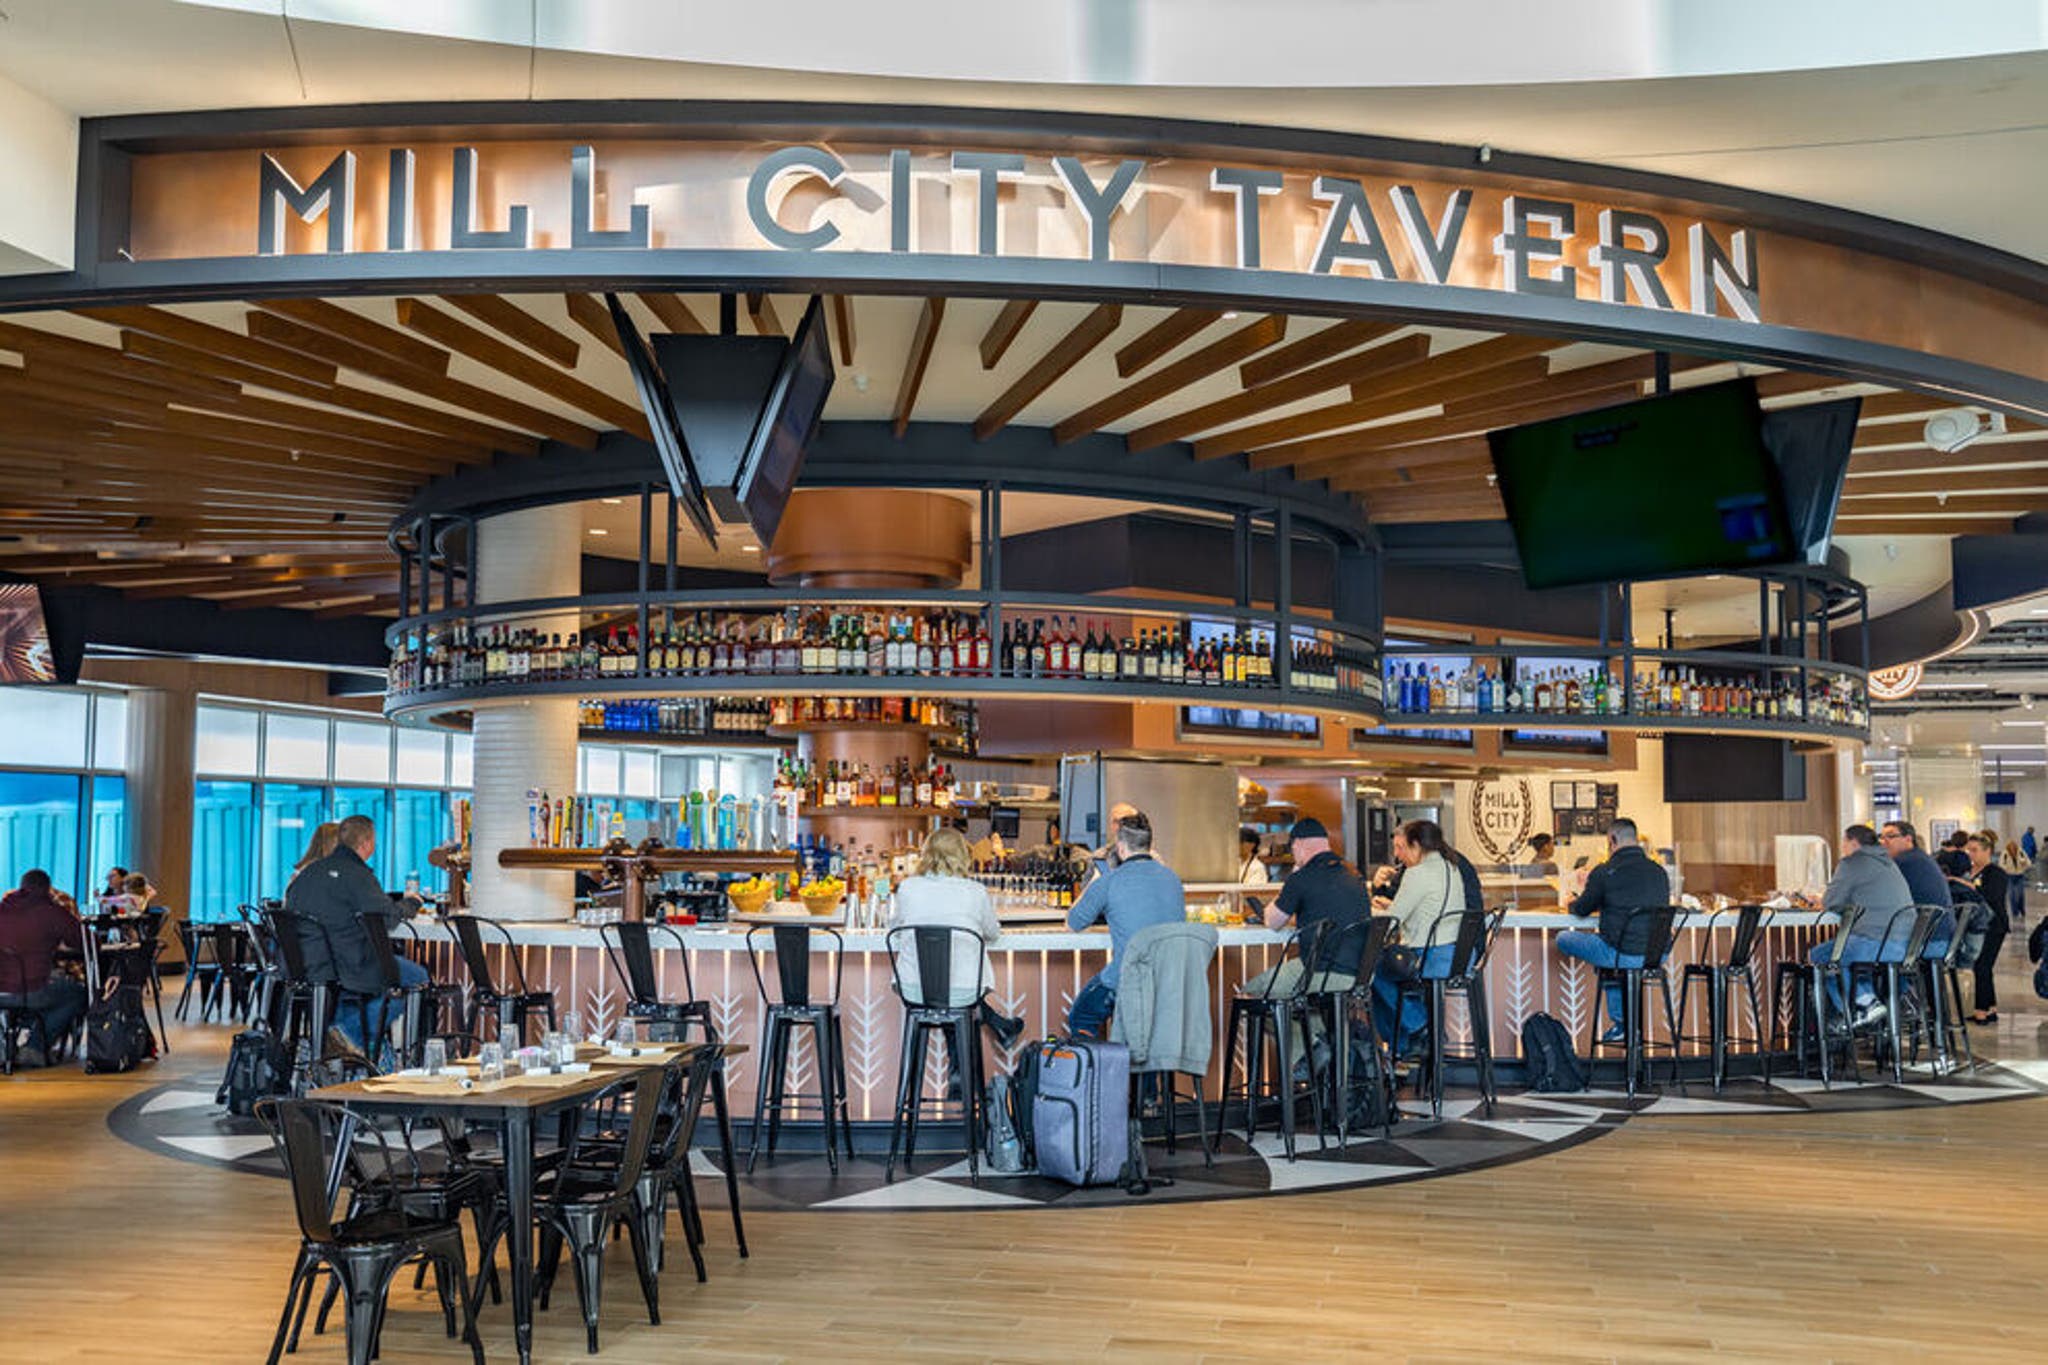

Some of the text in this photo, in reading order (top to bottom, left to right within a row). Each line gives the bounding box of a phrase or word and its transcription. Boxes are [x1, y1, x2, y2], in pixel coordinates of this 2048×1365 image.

[258, 145, 1763, 325] MILL CITY TAVERN
[1485, 792, 1519, 808] MILL
[1485, 811, 1519, 828] CITY
